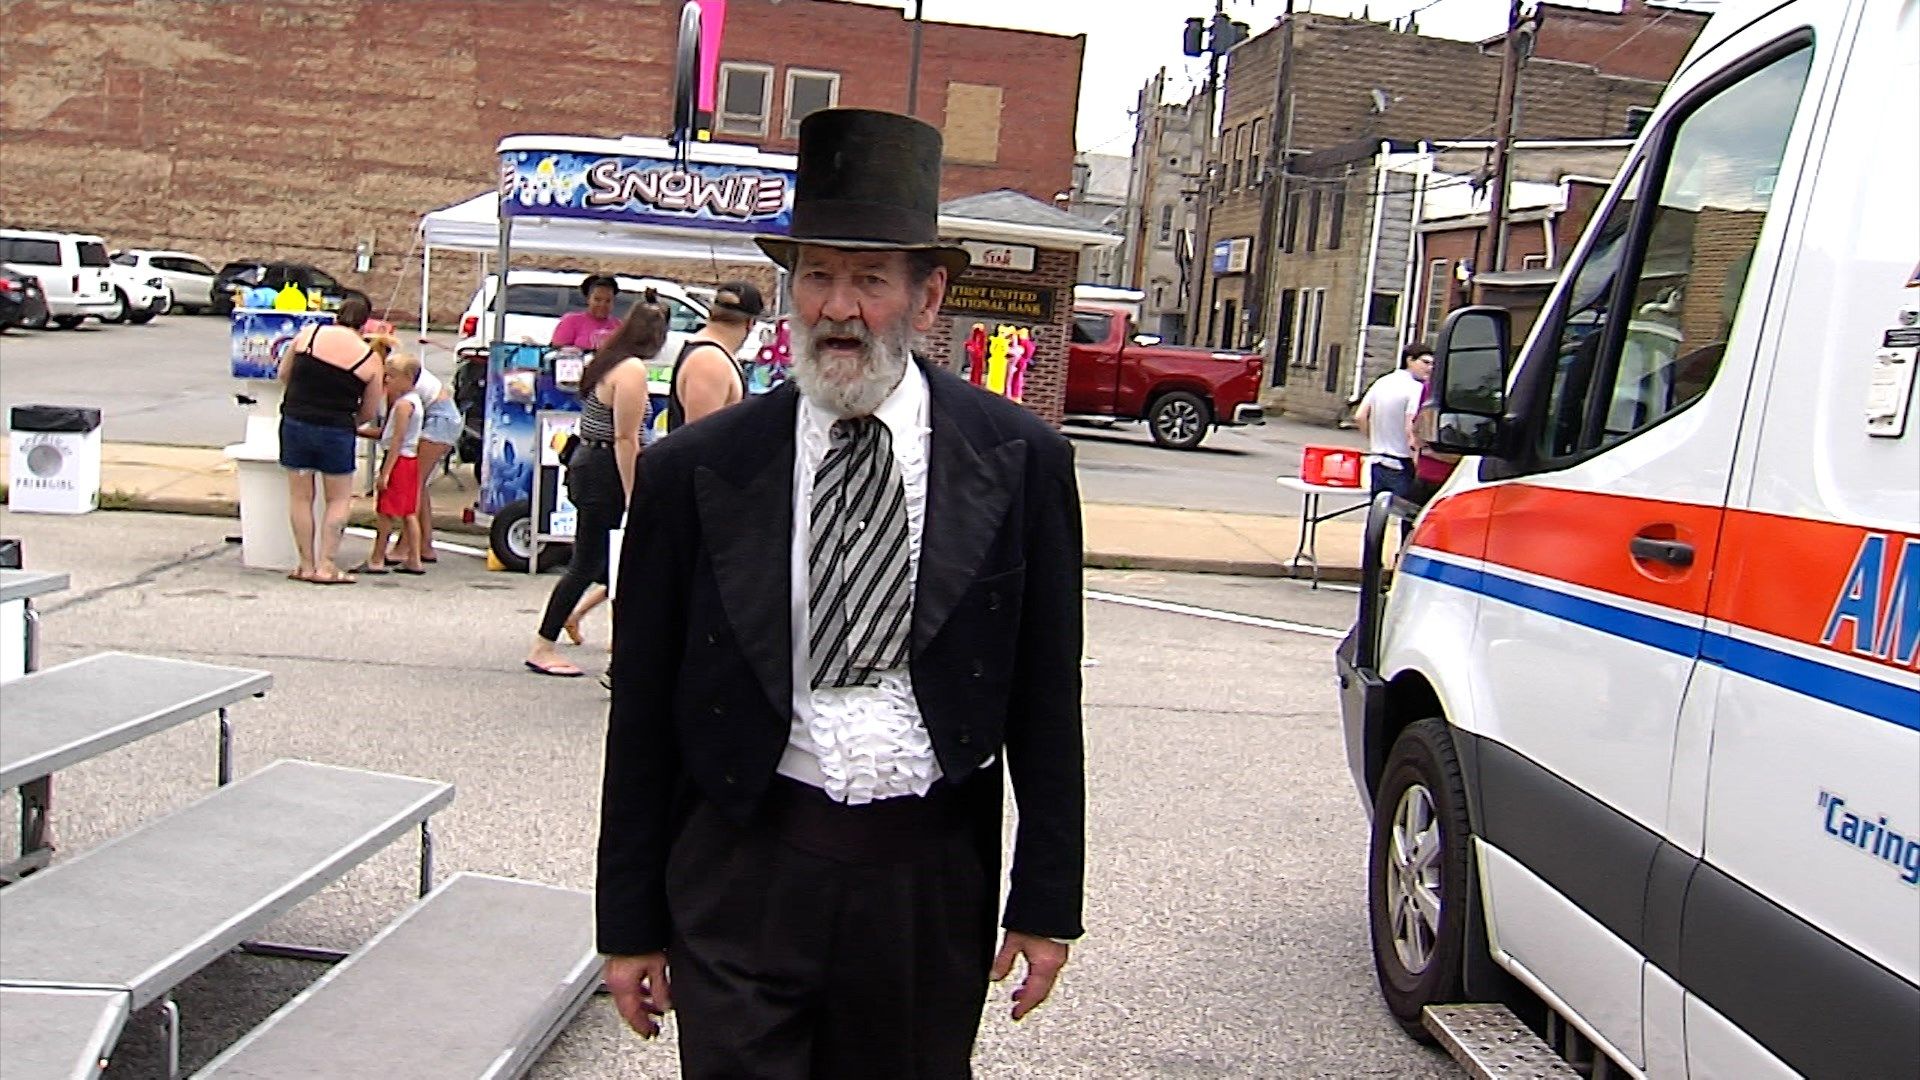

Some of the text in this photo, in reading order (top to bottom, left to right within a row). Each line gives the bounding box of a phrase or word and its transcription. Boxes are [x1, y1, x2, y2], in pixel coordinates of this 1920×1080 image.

[590, 160, 786, 215] SNOWIE
[951, 285, 1037, 302] FIRST UNITED
[1007, 302, 1041, 316] BANK
